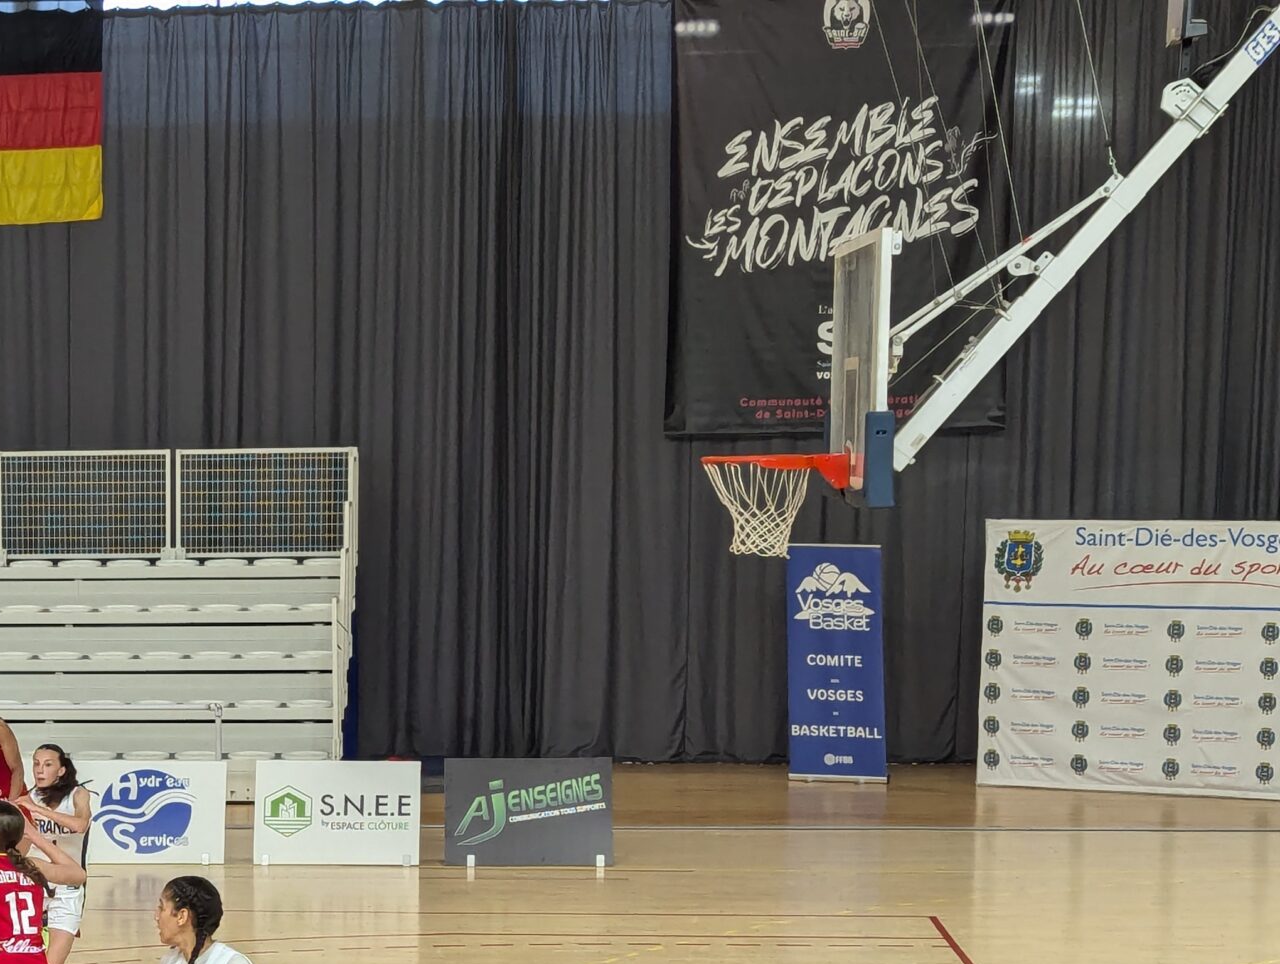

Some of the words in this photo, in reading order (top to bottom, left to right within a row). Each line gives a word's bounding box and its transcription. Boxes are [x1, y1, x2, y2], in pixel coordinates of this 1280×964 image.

[717, 96, 939, 178] ENSEMBLE
[704, 204, 741, 236] LES
[1070, 554, 1105, 576] Au
[1190, 558, 1221, 576] du
[797, 593, 864, 614] Vosges
[809, 613, 870, 631] Basket
[806, 654, 863, 667] COMITE
[807, 688, 864, 702] VOSGES
[791, 725, 883, 739] BASKETBALL
[507, 773, 603, 812] ENSEIGNES
[320, 794, 412, 817] S.N.E.E
[330, 821, 364, 831] ESPACE
[112, 823, 189, 854] Services
[5, 891, 38, 935] 12
